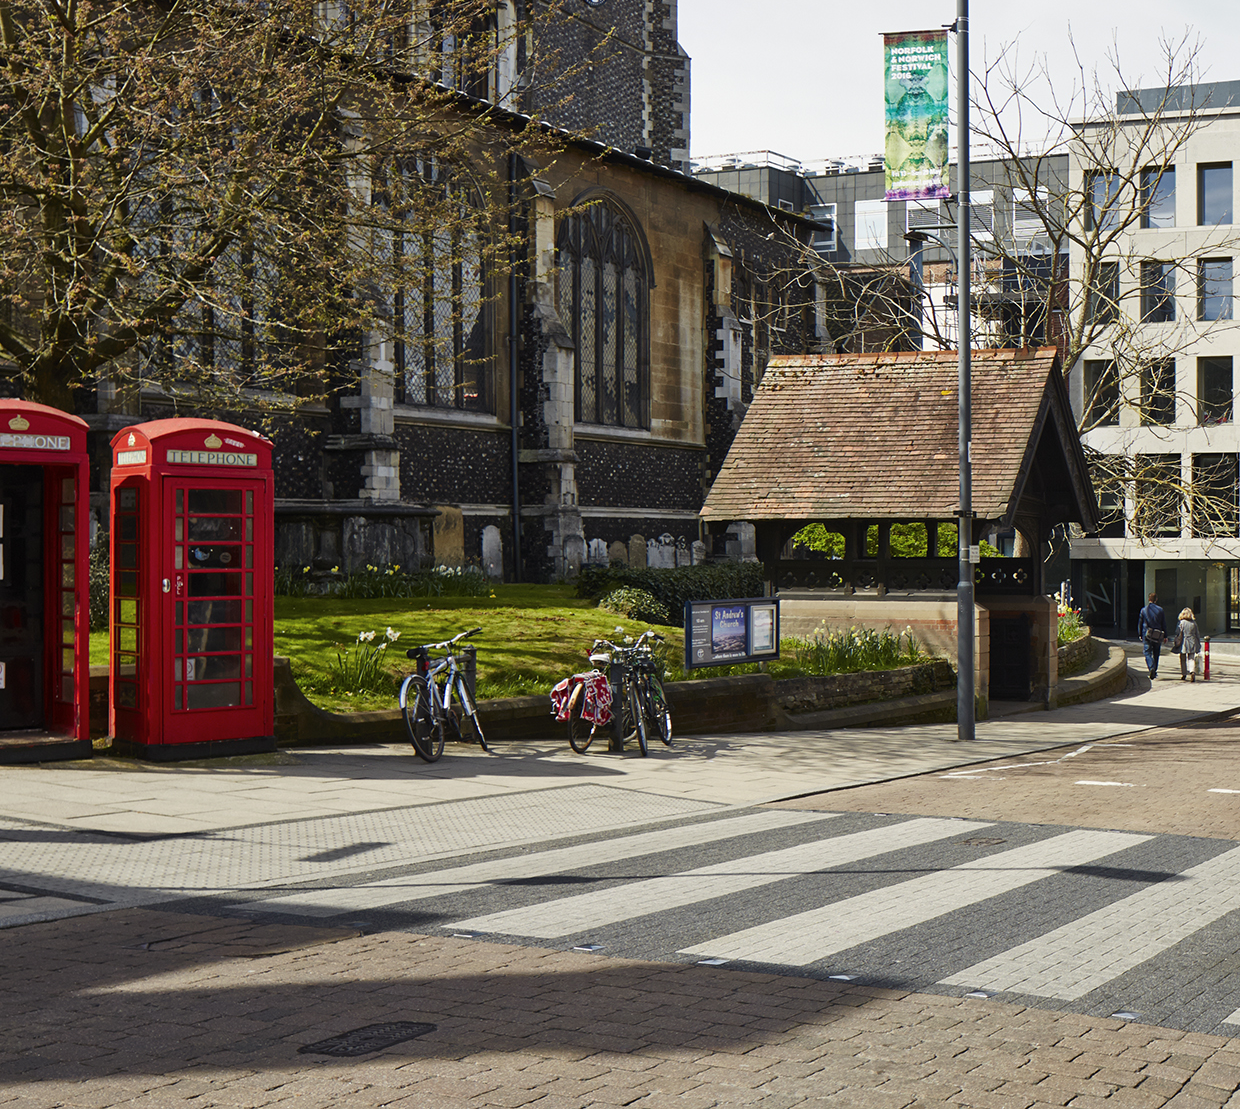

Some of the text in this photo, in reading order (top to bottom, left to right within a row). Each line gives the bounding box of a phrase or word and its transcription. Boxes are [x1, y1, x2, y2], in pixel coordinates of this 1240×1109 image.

[891, 46, 934, 55] NORFOLK
[898, 54, 941, 63] NORWICH
[891, 63, 933, 71] FESTIVAL
[171, 451, 254, 466] TELEPHONE
[720, 620, 740, 628] Church
